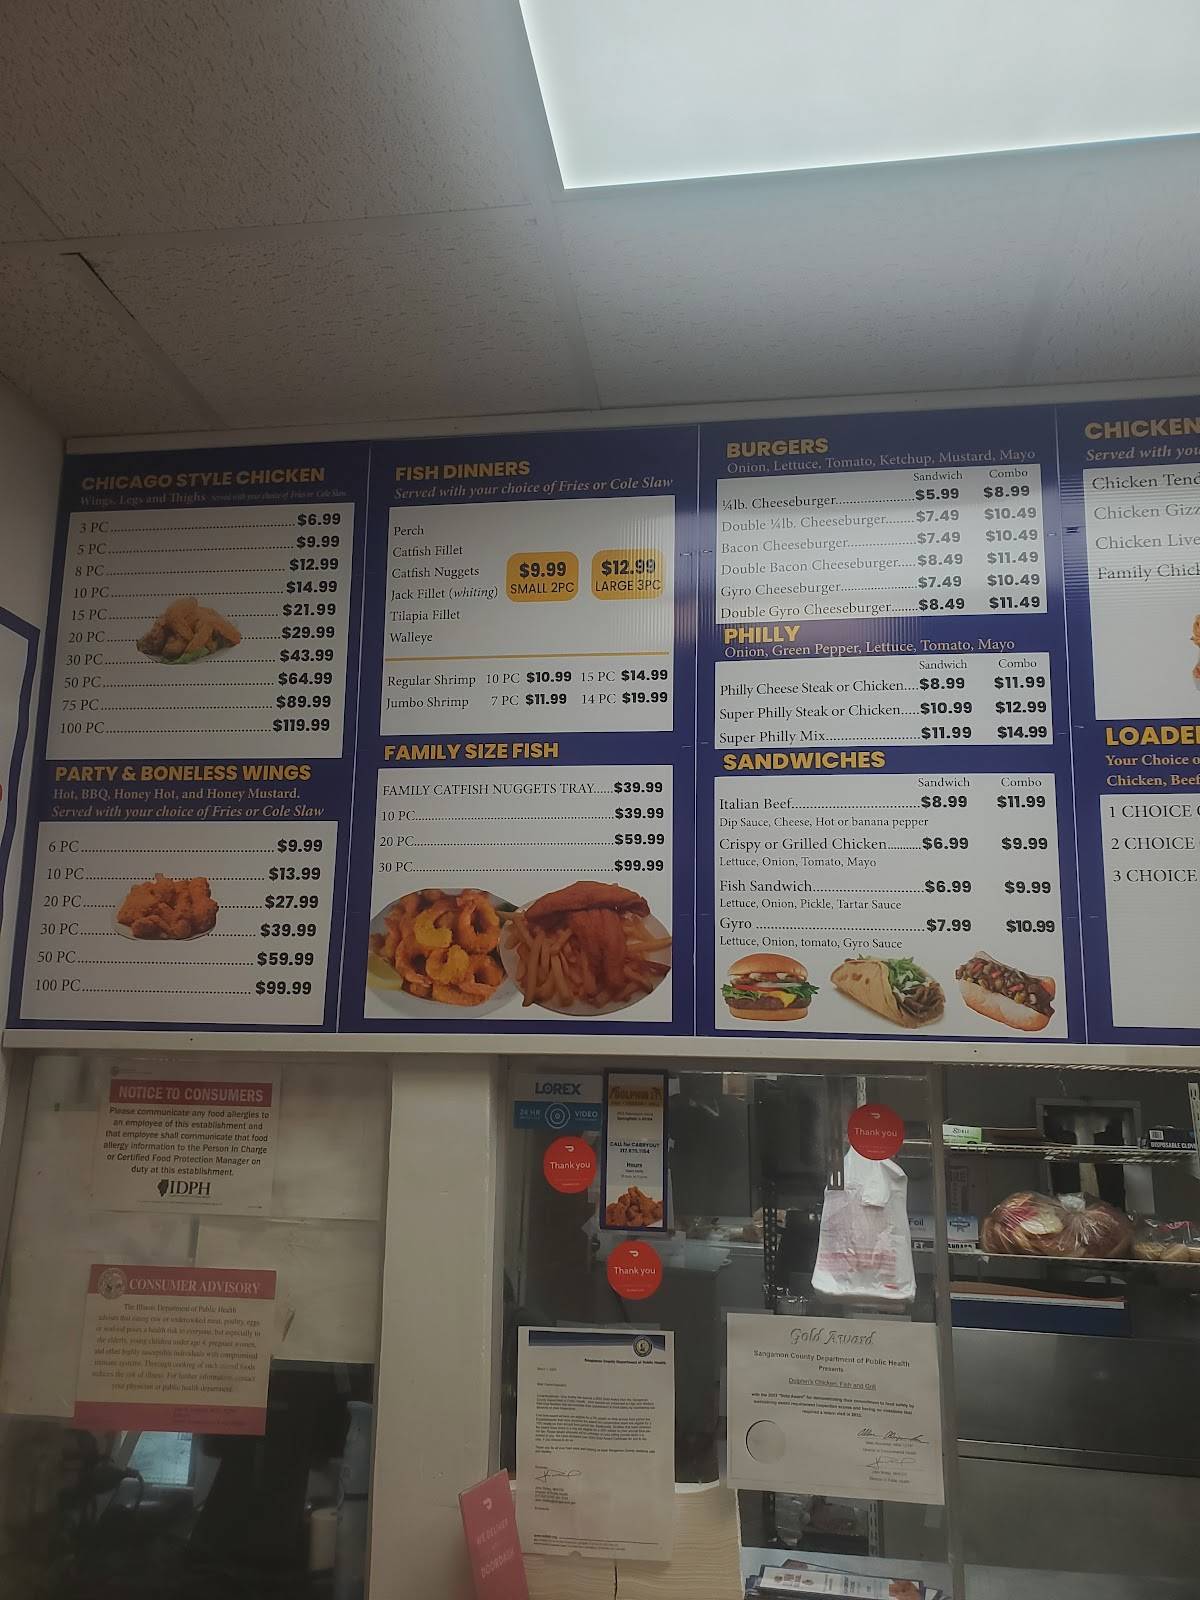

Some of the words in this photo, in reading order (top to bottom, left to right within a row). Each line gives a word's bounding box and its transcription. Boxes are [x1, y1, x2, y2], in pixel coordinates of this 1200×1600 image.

[726, 438, 829, 459] BURGERS
[727, 462, 770, 474] Onion,
[774, 459, 821, 472] Lettuce,
[825, 455, 877, 470] Tomato,
[879, 453, 936, 467] Ketchup,
[938, 450, 997, 464] Mustard,
[999, 449, 1036, 462] Mayo
[395, 466, 439, 481] FISH
[443, 461, 531, 479] DINNERS
[913, 471, 963, 482] Sandwich
[989, 468, 1028, 479] Combo
[81, 473, 172, 491] CHICAGO
[176, 472, 232, 487] STYLE
[235, 467, 326, 485] CHICKEN
[1092, 476, 1158, 490] Chicken
[395, 486, 435, 499] Served
[439, 485, 467, 498] with
[469, 486, 498, 498] your
[501, 481, 540, 494] choice
[543, 480, 559, 496] of
[560, 479, 590, 492] Fries
[592, 480, 607, 490] or
[610, 478, 638, 490] Cole
[641, 476, 673, 489] Slaw
[393, 525, 425, 537] Perch
[392, 546, 431, 558] Catfish
[435, 545, 463, 556] Fillet
[392, 567, 431, 579] Catfish
[434, 566, 480, 579] Nuggets
[519, 561, 567, 578] $9.99
[601, 558, 656, 576] $12.99
[510, 583, 548, 595] SMALL
[551, 582, 575, 593] 2PC
[595, 580, 634, 592] LARGE
[636, 579, 662, 591] 3PC
[391, 588, 413, 601] Jack
[417, 588, 445, 600] Fillet
[449, 586, 499, 600] (whiting)
[721, 606, 766, 620] Double
[769, 605, 801, 618] Gyro
[804, 601, 893, 616] Cheeseburger
[918, 597, 965, 612] $8.49
[989, 595, 1041, 610] $11.49
[390, 609, 429, 624] Tilapia
[432, 609, 460, 621] Fillet
[389, 632, 433, 645] Walleye
[724, 624, 801, 644] PHILLY
[725, 647, 769, 659] Onion,
[772, 644, 811, 657] Green
[814, 642, 862, 657] Pepper,
[865, 640, 917, 653] Lettuce,
[920, 639, 974, 652] Tomato,
[977, 638, 1015, 652] Mayo
[387, 674, 431, 689] Regular
[434, 673, 476, 688] Shrimp
[486, 673, 499, 684] 10
[502, 673, 520, 684] PC
[526, 670, 572, 684] $10.99
[581, 671, 594, 682] 15
[597, 670, 616, 682] PC
[621, 668, 668, 682] $14.99
[719, 708, 755, 721] Super
[757, 705, 793, 720] Philly
[796, 704, 829, 717] Steak
[832, 707, 846, 716] or
[849, 703, 900, 716] Chicken
[920, 701, 973, 715] $10.99
[995, 701, 1047, 714] $12.99
[59, 721, 83, 734] 100
[272, 718, 330, 732] $119.99
[384, 744, 461, 761] FAMILY
[465, 743, 508, 759] SIZE
[512, 742, 559, 759] FISH
[723, 751, 886, 770] SANDWICHES
[55, 766, 117, 782] PARTY
[121, 767, 136, 780] &
[140, 766, 237, 781] BONELESS
[242, 764, 312, 780] WINGS
[382, 784, 430, 796] FAMILY
[433, 783, 489, 796] CATFISH
[493, 783, 557, 795] NUGGETS
[560, 783, 594, 794] TRAY
[613, 781, 663, 794] $39.99
[1106, 775, 1167, 787] Chicken,
[53, 789, 78, 800] Hot,
[81, 788, 111, 801] BBQ,
[114, 788, 151, 802] Honey
[154, 789, 179, 800] Hot,
[182, 788, 204, 799] and
[207, 787, 245, 801] Honey
[248, 787, 300, 799] Mustard.
[719, 817, 738, 829] Dip
[740, 817, 771, 828] Sauce,
[774, 816, 812, 828] Cheese,
[815, 816, 835, 827] Hot
[838, 818, 849, 827] or
[851, 816, 889, 827] banana
[892, 817, 929, 829] pepper
[40, 923, 55, 935] 30
[260, 923, 317, 938] $39.99
[719, 935, 759, 948] Lettuce,
[762, 937, 798, 948] Onion,
[801, 937, 840, 949] tomato,
[843, 937, 870, 951] Gyro
[872, 938, 903, 949] Sauce
[119, 1085, 163, 1099] NOTICE
[166, 1087, 180, 1100] TO
[185, 1087, 264, 1102] CONSUMERS
[535, 1081, 582, 1096] LOREX
[109, 1107, 135, 1115] Please
[137, 1108, 190, 1117] communicate
[208, 1109, 225, 1117] food
[227, 1110, 259, 1119] allergies
[125, 1120, 163, 1129] employee
[165, 1120, 173, 1128] of
[175, 1120, 189, 1128] this
[191, 1121, 246, 1130] establishment
[248, 1122, 263, 1130] and
[854, 1128, 879, 1137] Thank
[881, 1129, 898, 1138] you
[131, 1165, 148, 1175] duty
[161, 1166, 175, 1174] this
[177, 1167, 234, 1176] establishment.
[550, 1161, 574, 1170] Thank
[576, 1162, 591, 1171] you
[170, 1180, 211, 1196] IDPH
[614, 1266, 639, 1275] Thank
[640, 1267, 656, 1276] you
[129, 1279, 197, 1292] CONSUMER
[200, 1280, 261, 1294] ADVISORY
[790, 1328, 823, 1346] Gold
[824, 1330, 876, 1345] Award
[754, 1350, 789, 1359] Sangamon
[790, 1352, 814, 1362] County
[816, 1354, 854, 1364] Department
[856, 1356, 864, 1364] of
[865, 1357, 886, 1366] Public
[888, 1359, 910, 1368] Health
[819, 1365, 844, 1373] Presents
